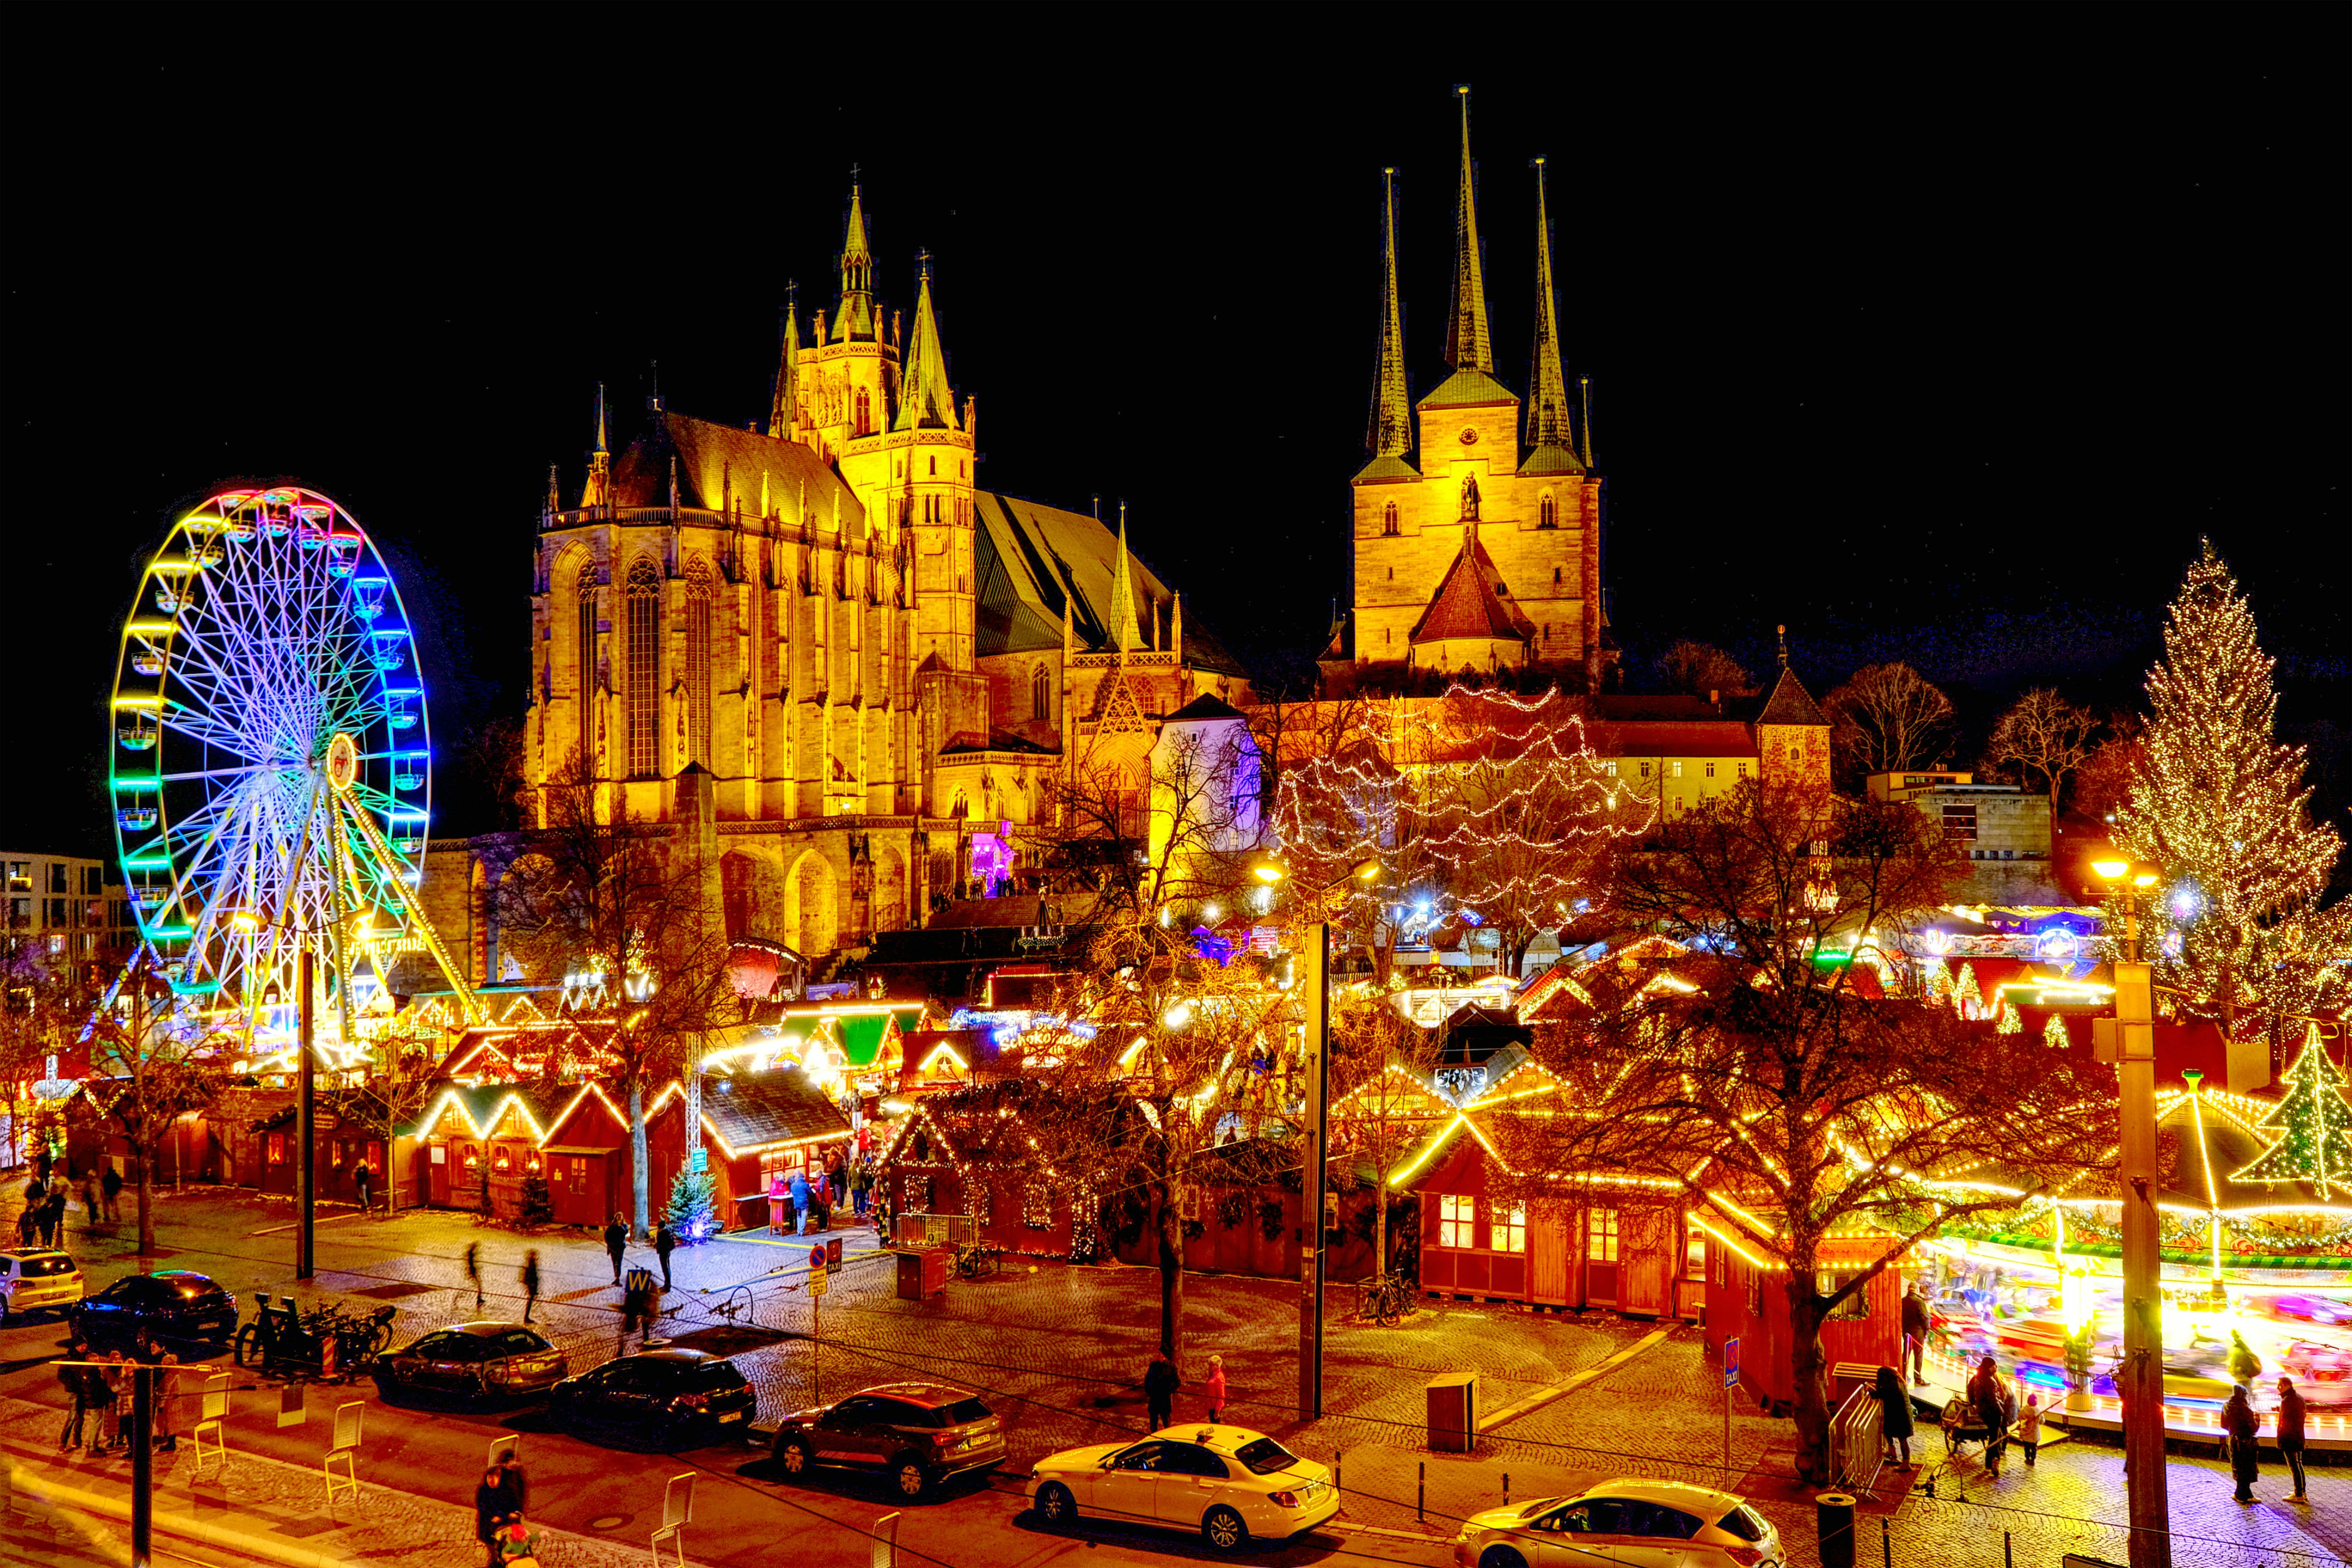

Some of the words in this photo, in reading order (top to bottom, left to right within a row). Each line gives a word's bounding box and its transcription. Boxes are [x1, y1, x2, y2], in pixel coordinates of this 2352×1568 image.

[1036, 1022, 1053, 1030] Die
[828, 1262, 841, 1272] TAXI
[629, 1271, 649, 1291] W
[1726, 1371, 1738, 1384] TAXI
